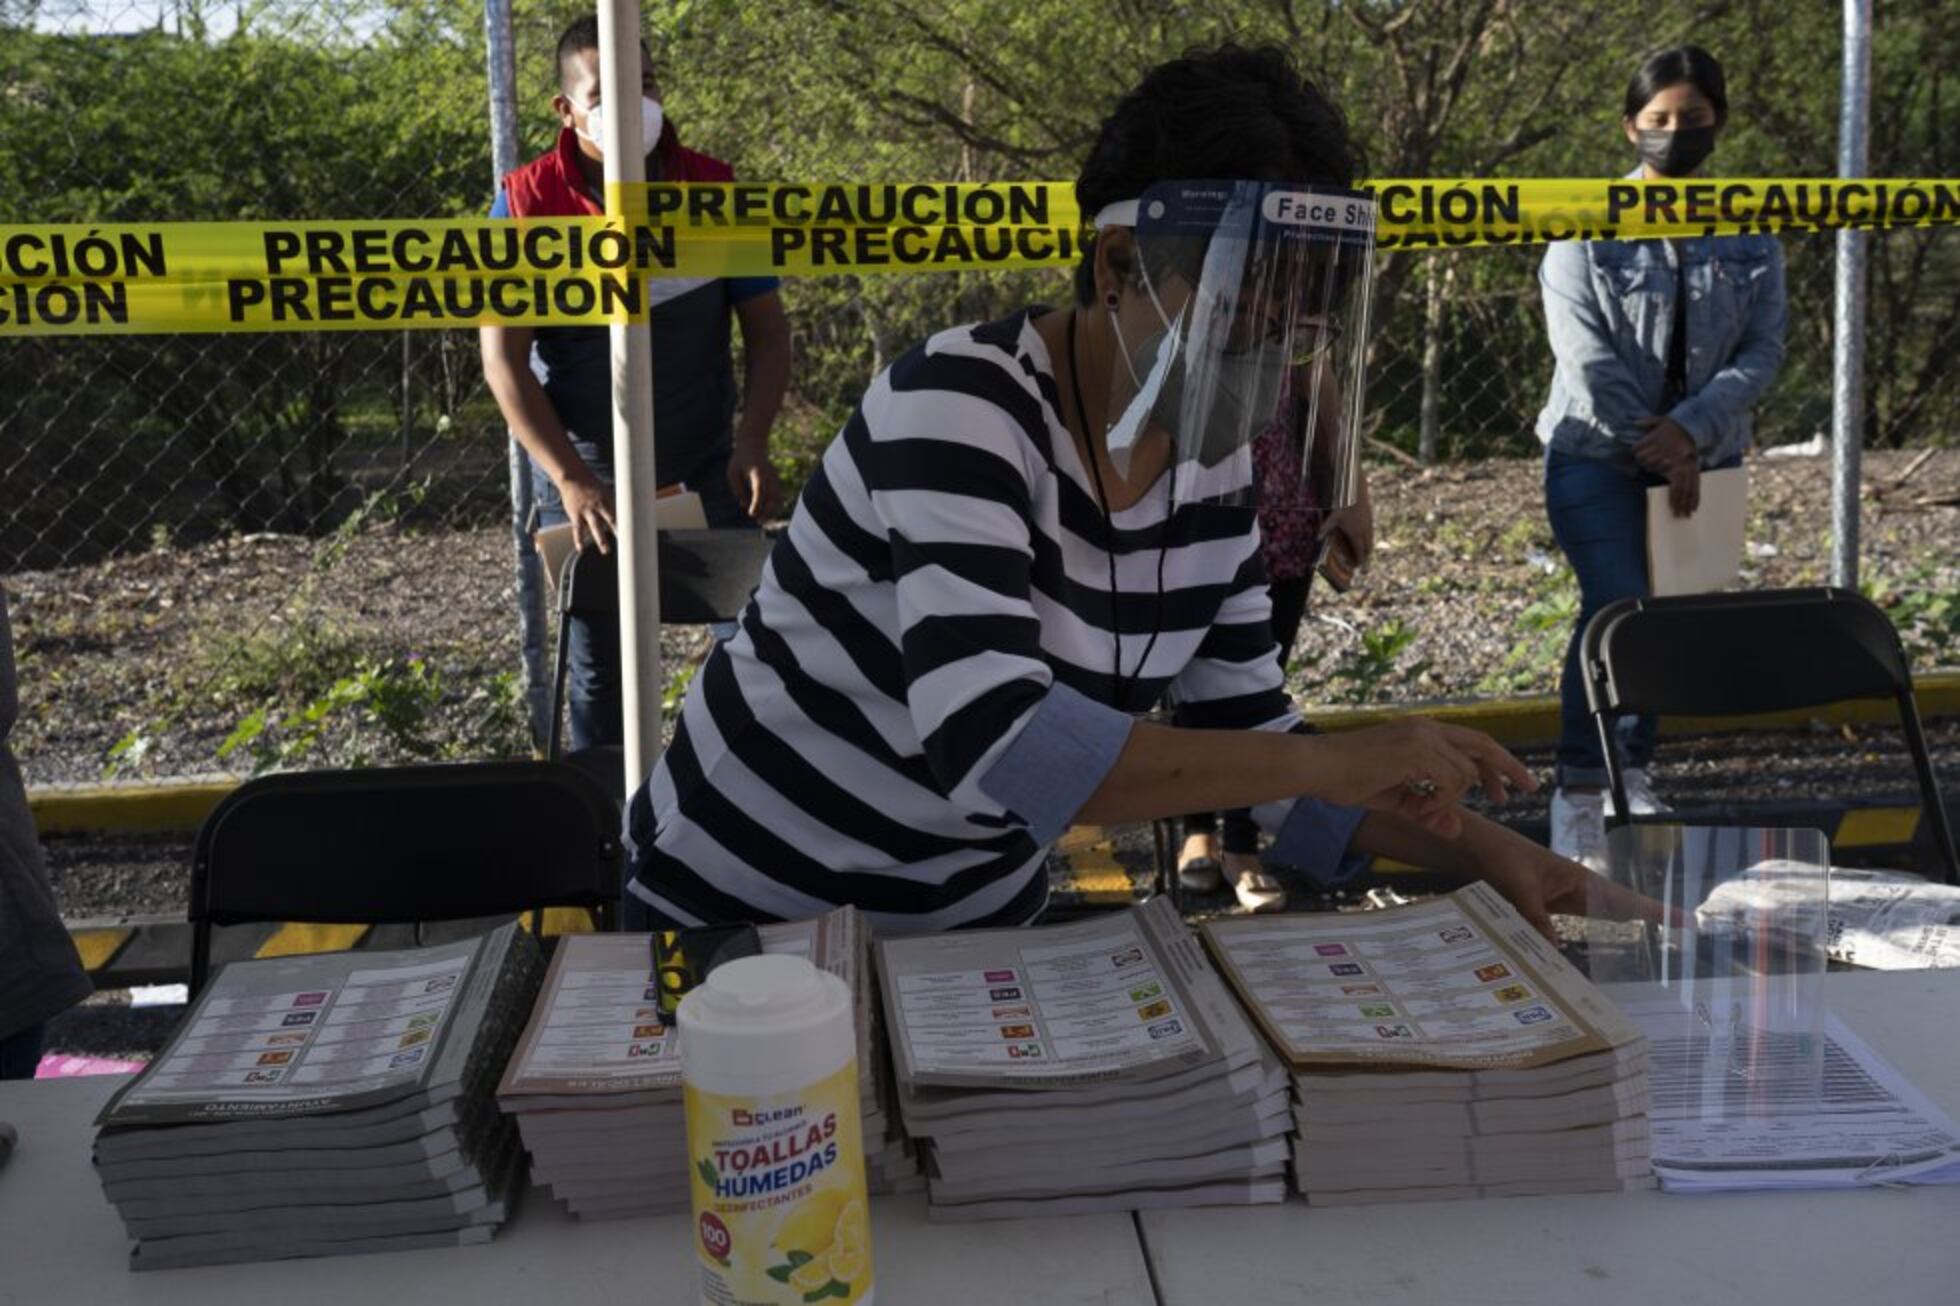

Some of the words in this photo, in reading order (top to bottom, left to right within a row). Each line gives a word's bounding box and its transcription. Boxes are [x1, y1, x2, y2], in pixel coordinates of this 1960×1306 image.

[647, 182, 1049, 227] PRECAUCIÓN
[1278, 197, 1336, 223] Face
[1364, 182, 1520, 225] CIÓN
[0, 229, 167, 277] CIÓN
[263, 221, 676, 274] PRECAUCIÓN
[771, 227, 1072, 267] PRECAUCI
[714, 1112, 837, 1174] TOALLAS
[714, 1141, 837, 1199] HÚMEDAS
